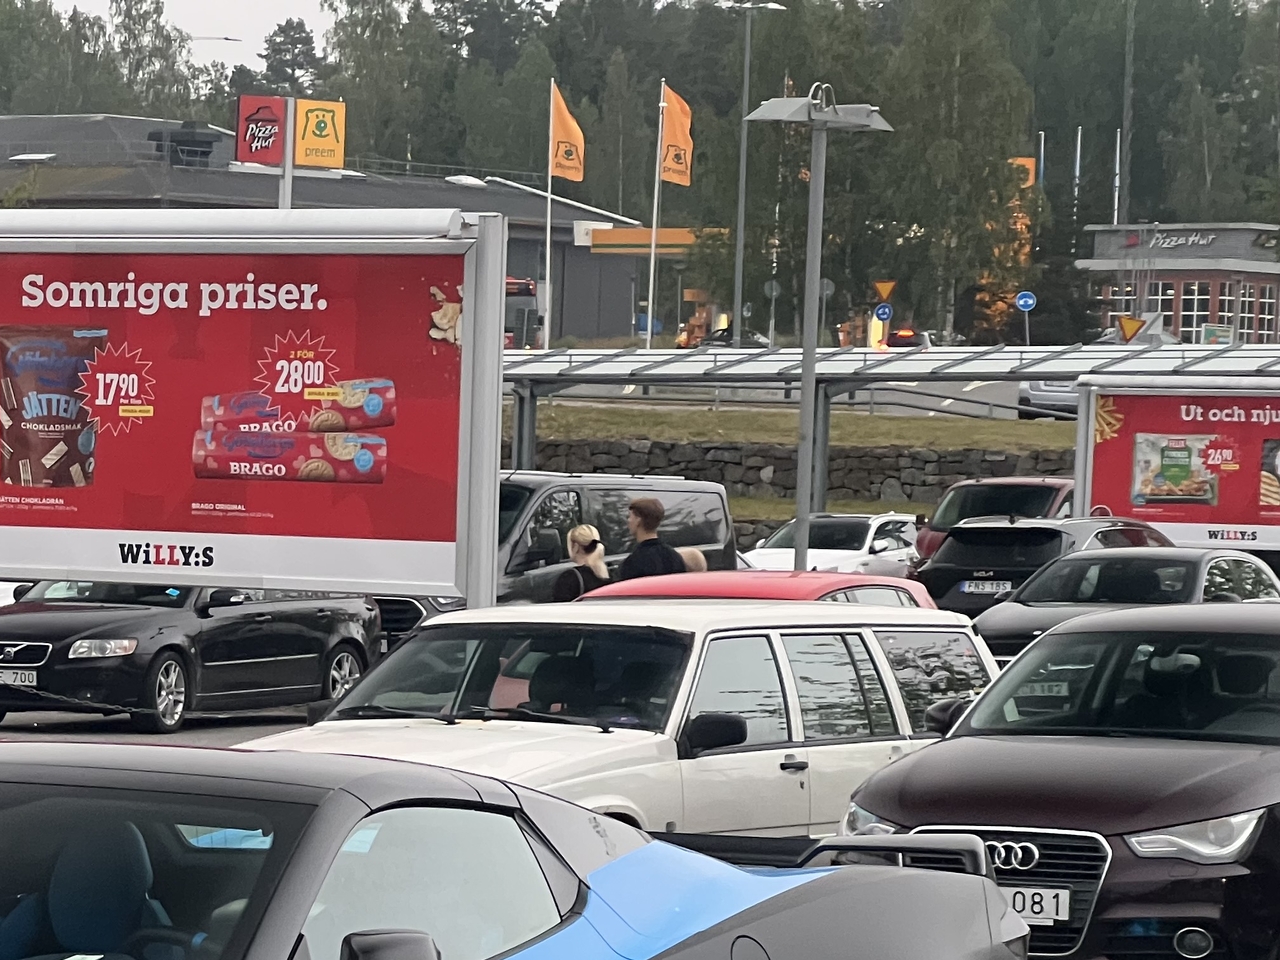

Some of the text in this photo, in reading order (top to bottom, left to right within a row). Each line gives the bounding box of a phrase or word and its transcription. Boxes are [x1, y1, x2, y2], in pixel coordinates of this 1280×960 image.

[245, 122, 279, 141] Pizza
[251, 136, 277, 152] Hut
[304, 147, 335, 158] preem
[1149, 232, 1217, 248] Pizza Hut
[22, 272, 328, 316] Somriga priser.
[297, 349, 314, 358] FÖR
[22, 391, 81, 420] JÄTTEN
[1181, 405, 1204, 421] Ut
[1208, 406, 1246, 422] och
[21, 422, 82, 431] CHOKLADSMAK
[229, 462, 286, 476] BRAGO
[1208, 530, 1257, 541] WiLLY:S
[119, 543, 214, 567] WiLLY:S
[13, 672, 34, 683] 700
[1013, 891, 1060, 916] 081
